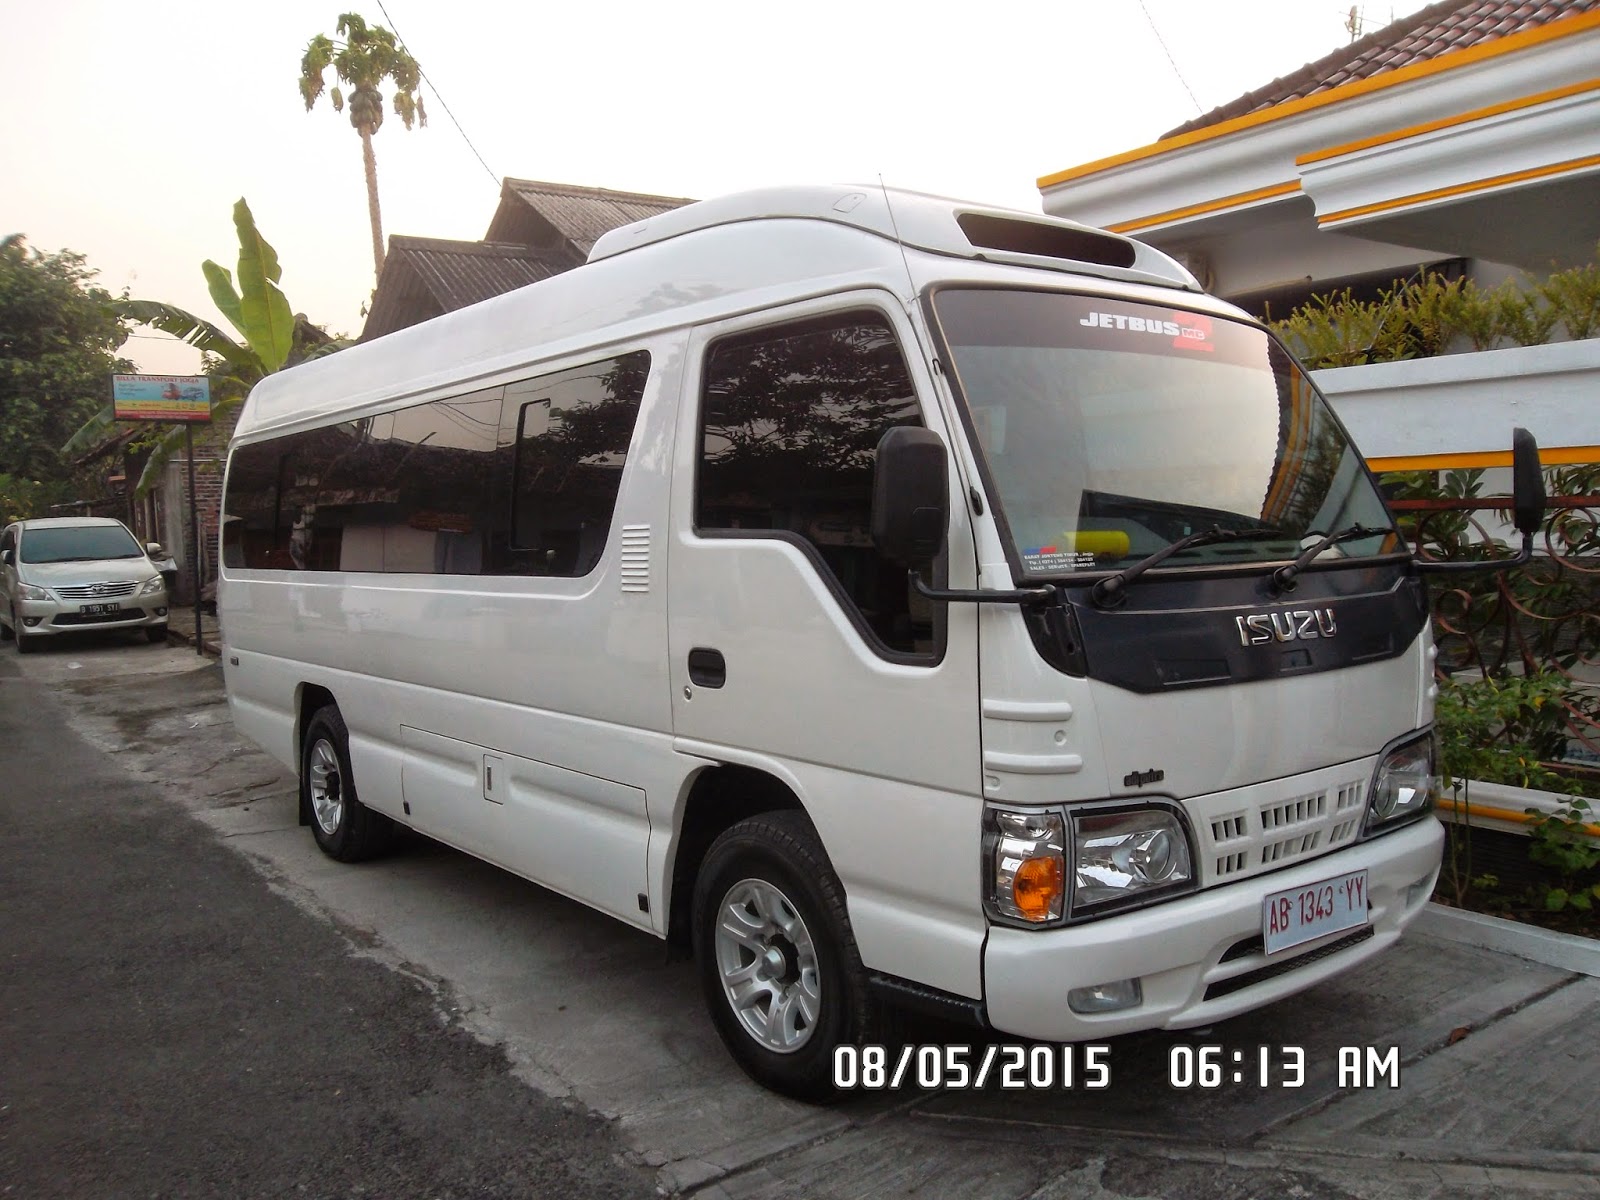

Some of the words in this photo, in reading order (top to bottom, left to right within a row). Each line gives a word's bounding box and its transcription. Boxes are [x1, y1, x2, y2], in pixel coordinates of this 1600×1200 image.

[1079, 312, 1180, 336] JETBUS
[1236, 608, 1337, 647] ISUZU
[1270, 897, 1290, 935] AB
[1298, 885, 1333, 926] 1343
[1346, 876, 1364, 911] YY
